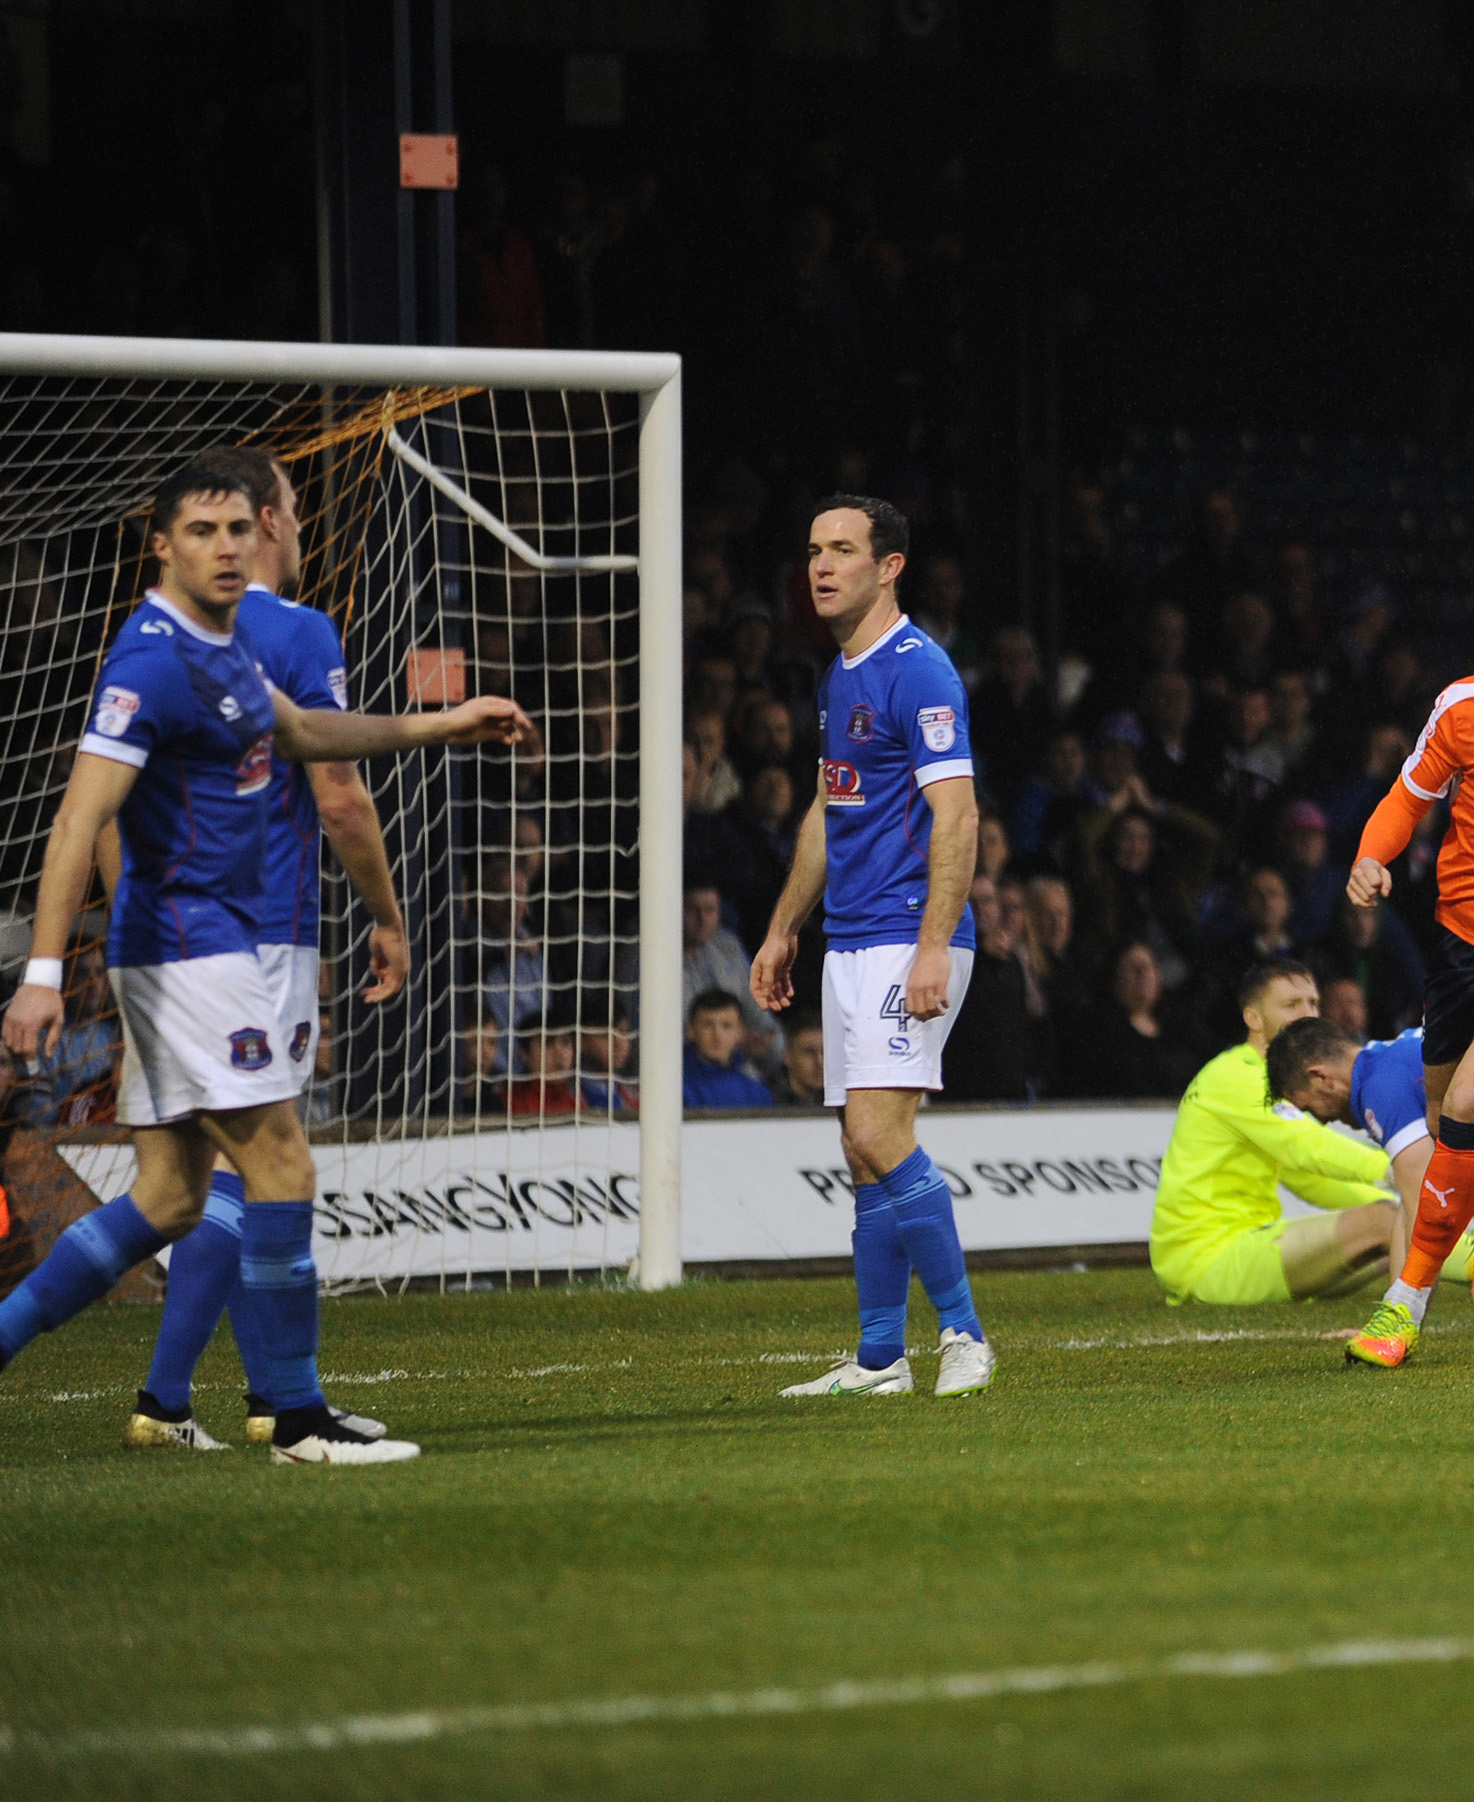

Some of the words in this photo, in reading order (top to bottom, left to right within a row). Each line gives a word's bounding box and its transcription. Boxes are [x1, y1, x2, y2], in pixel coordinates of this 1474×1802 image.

[880, 984, 912, 1033] 4
[800, 1161, 973, 1206] PRD
[974, 1155, 1163, 1198] SPONSO
